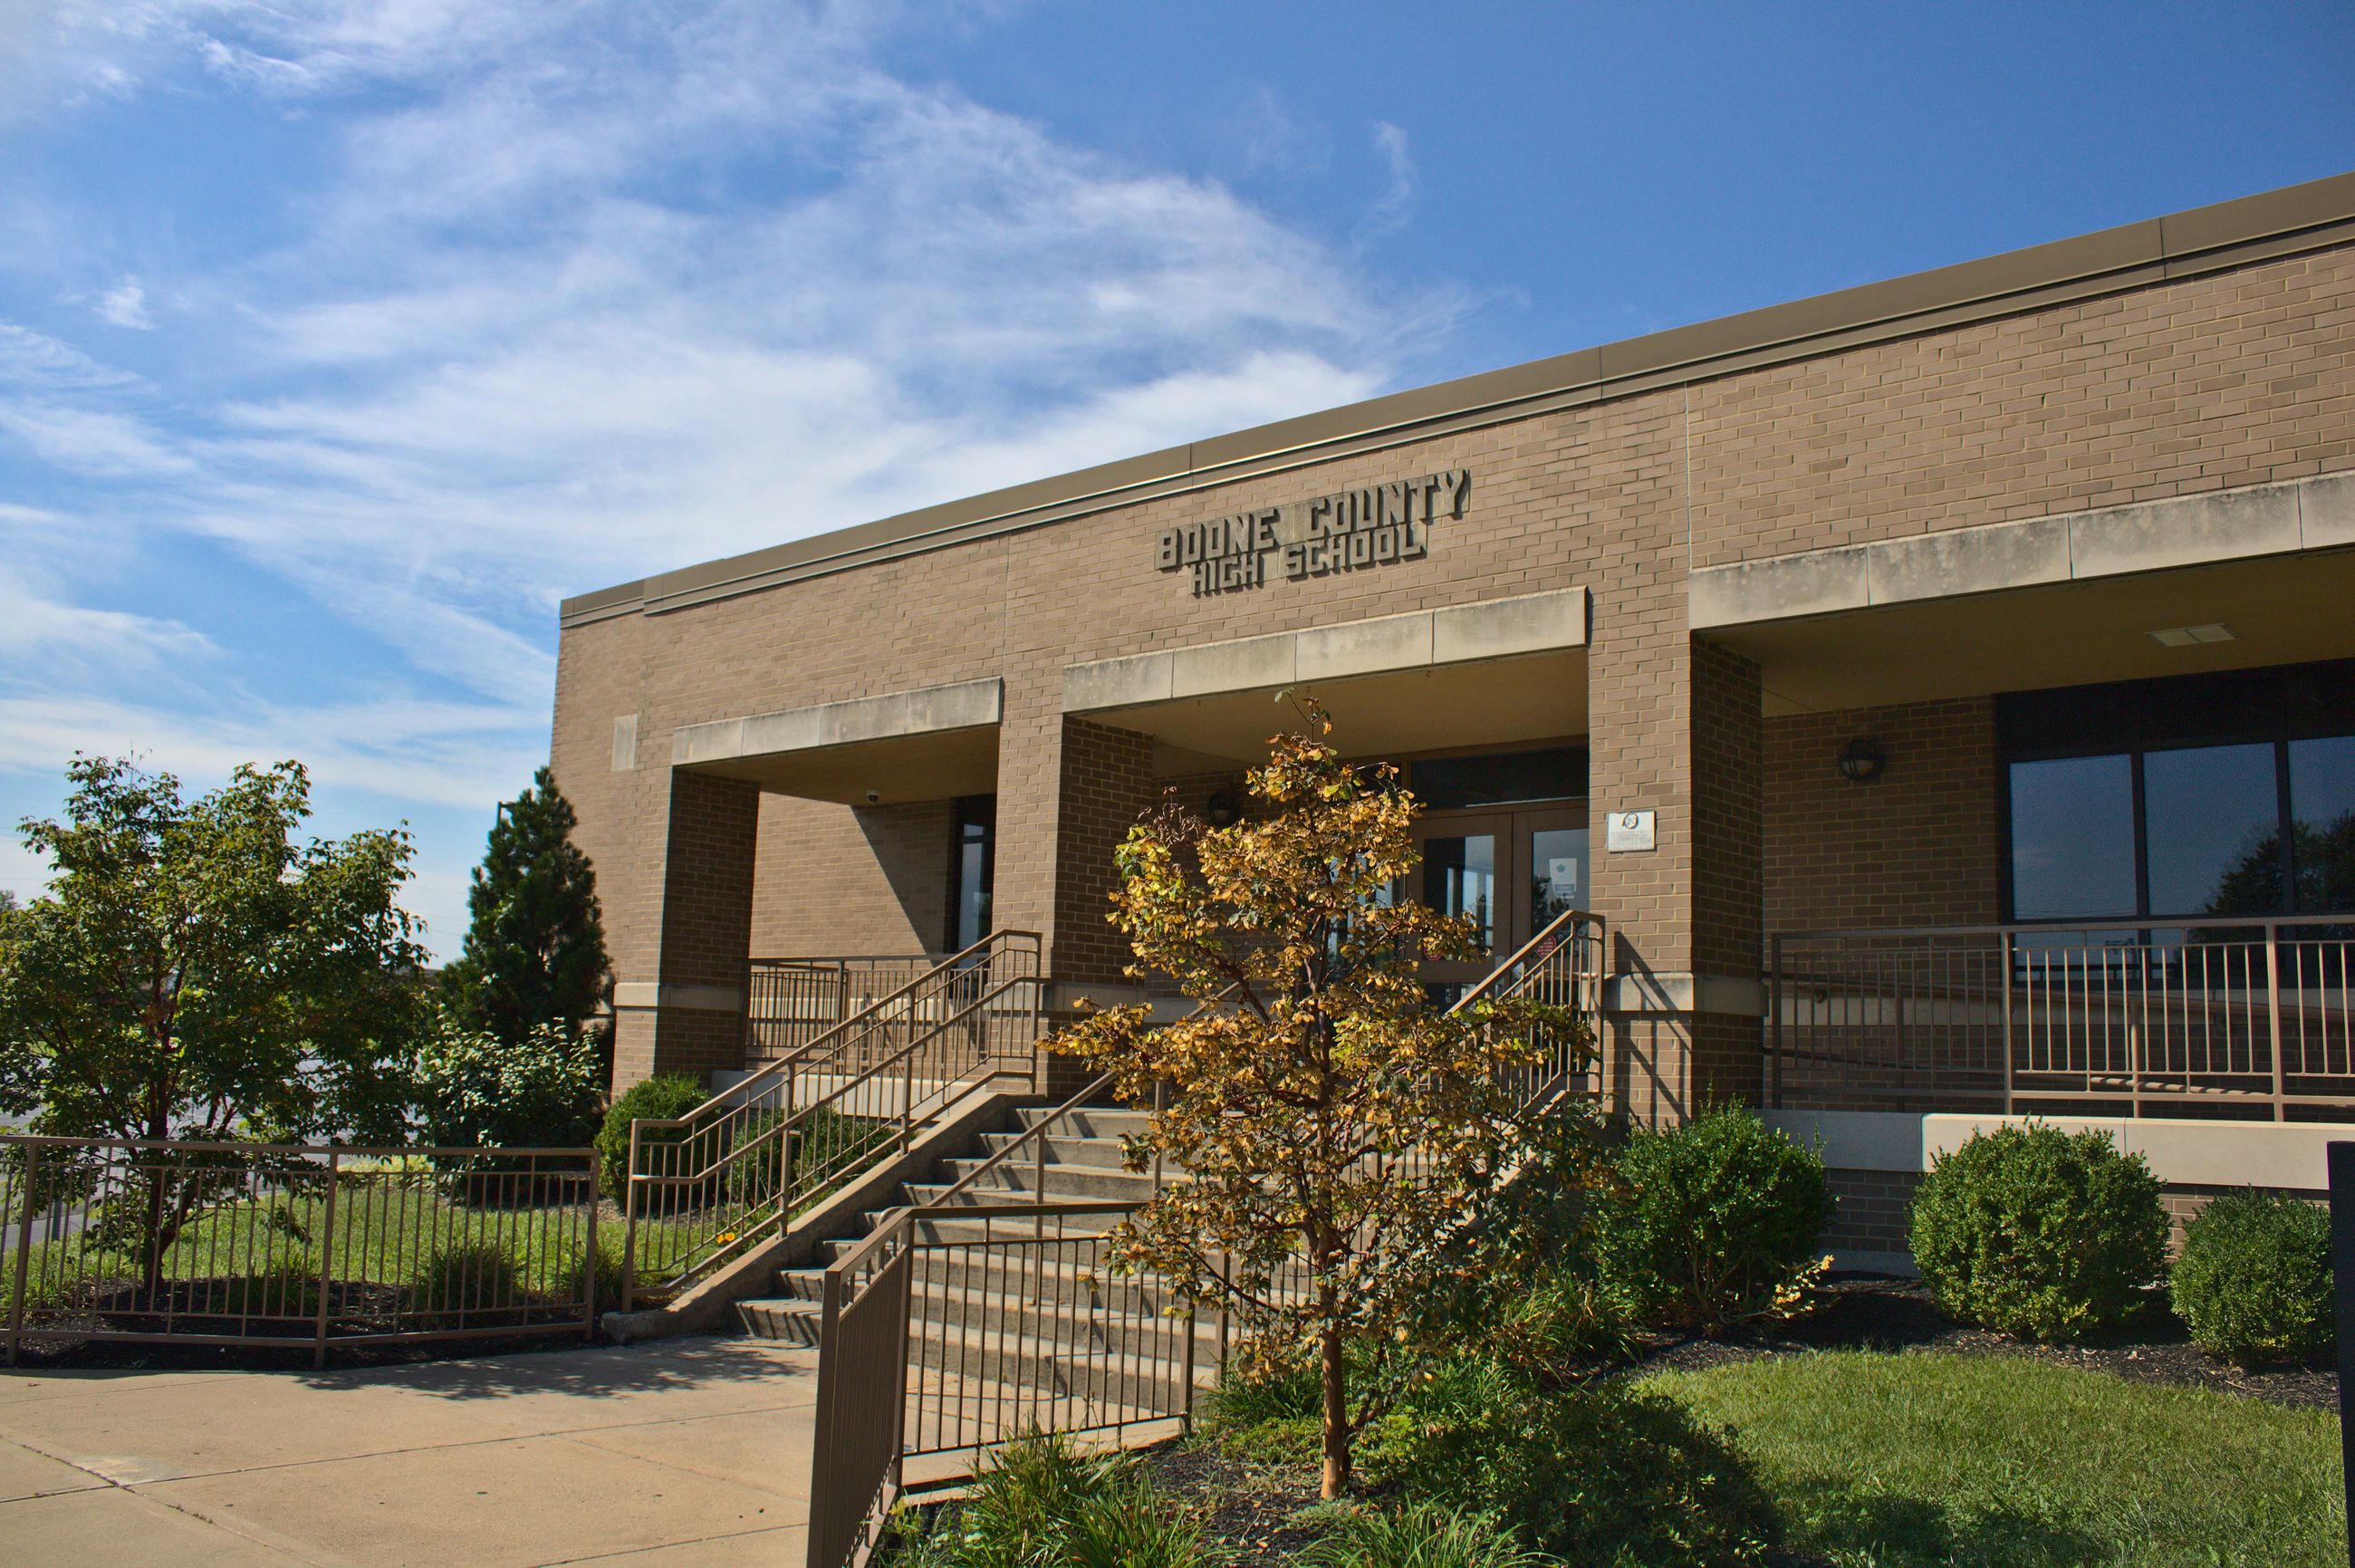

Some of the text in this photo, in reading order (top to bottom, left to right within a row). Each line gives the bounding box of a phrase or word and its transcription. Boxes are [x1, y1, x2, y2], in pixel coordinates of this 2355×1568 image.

[1157, 468, 1466, 569] BOONE COUNTY
[1190, 523, 1423, 593] HIGH SCHOOL
